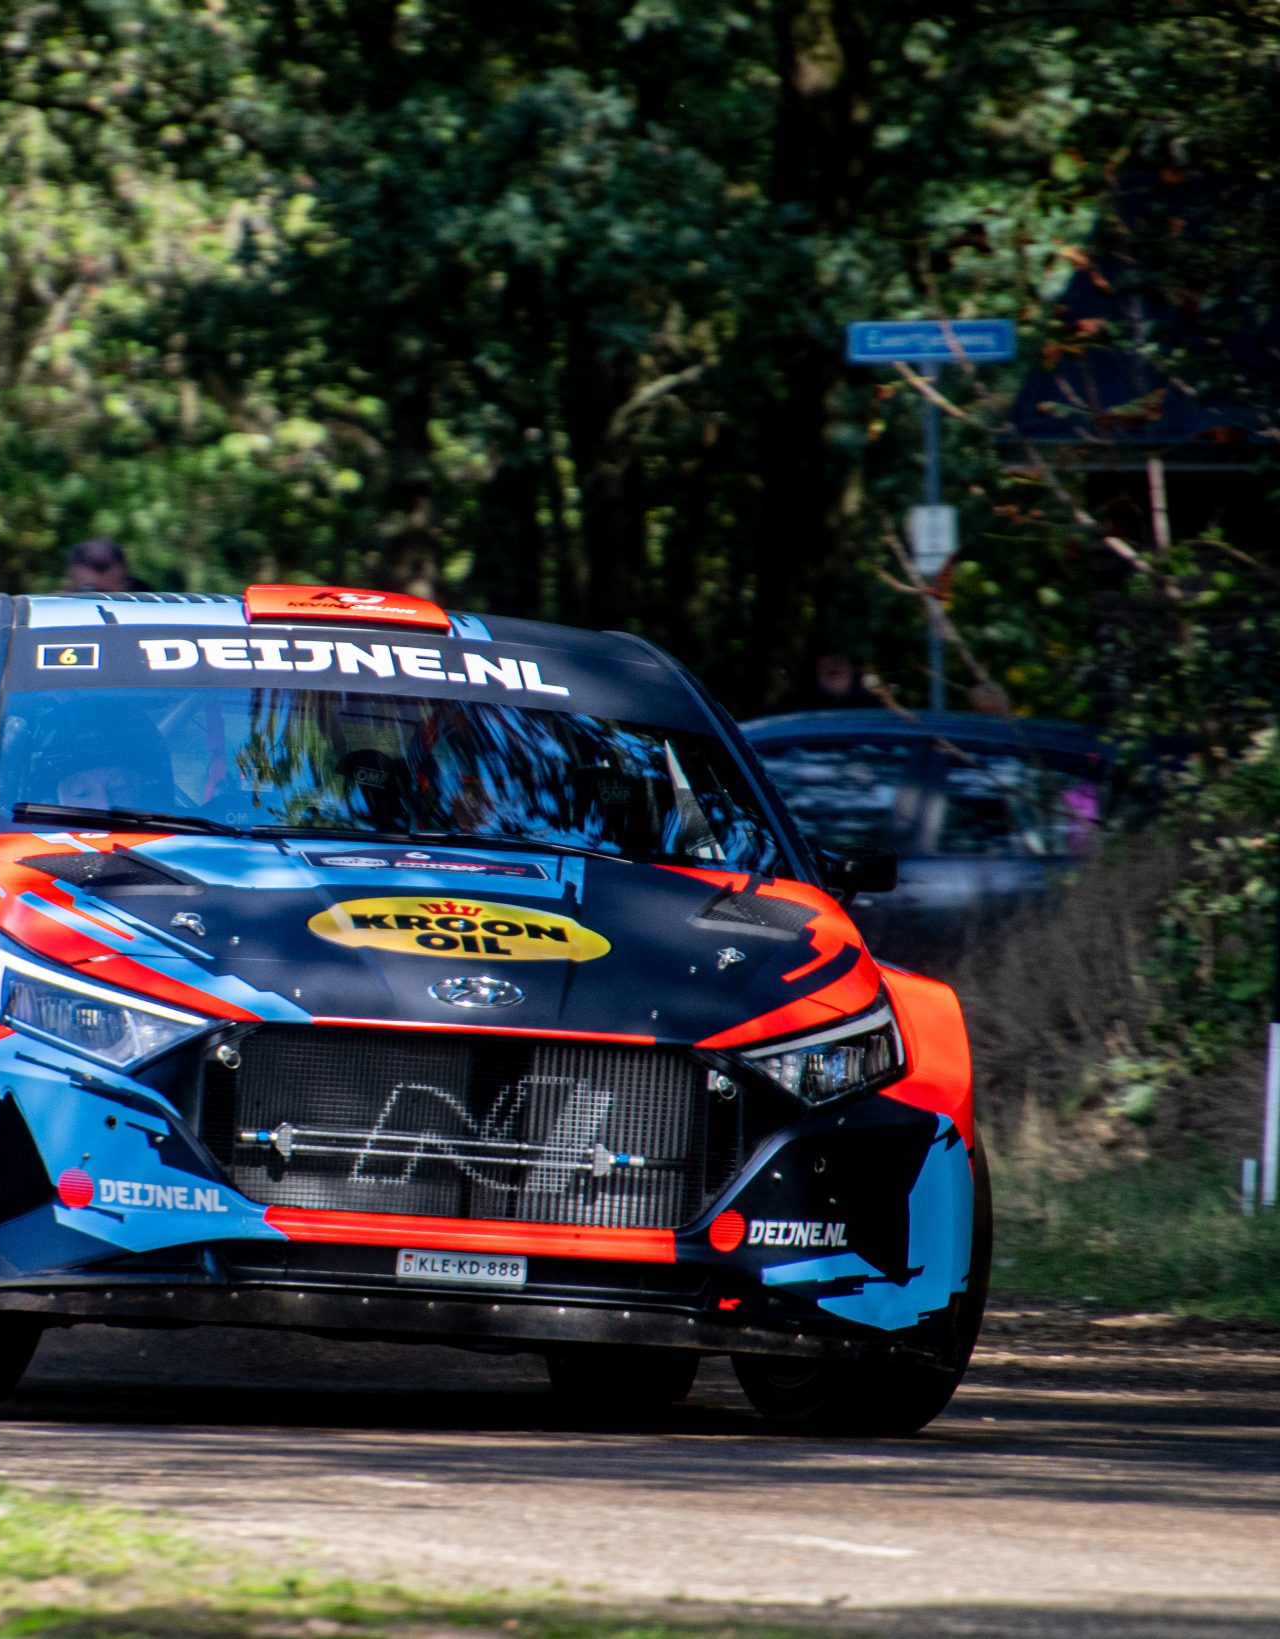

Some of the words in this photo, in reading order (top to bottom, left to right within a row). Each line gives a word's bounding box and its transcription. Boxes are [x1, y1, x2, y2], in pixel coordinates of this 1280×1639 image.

[58, 649, 78, 665] 6
[138, 638, 570, 697] DEIJNE.NL
[405, 851, 431, 860] 6
[350, 914, 569, 943] KROON
[416, 932, 512, 955] OIL
[98, 1178, 228, 1213] DEIJNE.NL
[747, 1219, 848, 1248] DEIJNE.NL
[403, 1262, 412, 1272] D
[419, 1257, 520, 1277] KLE-KD-888
